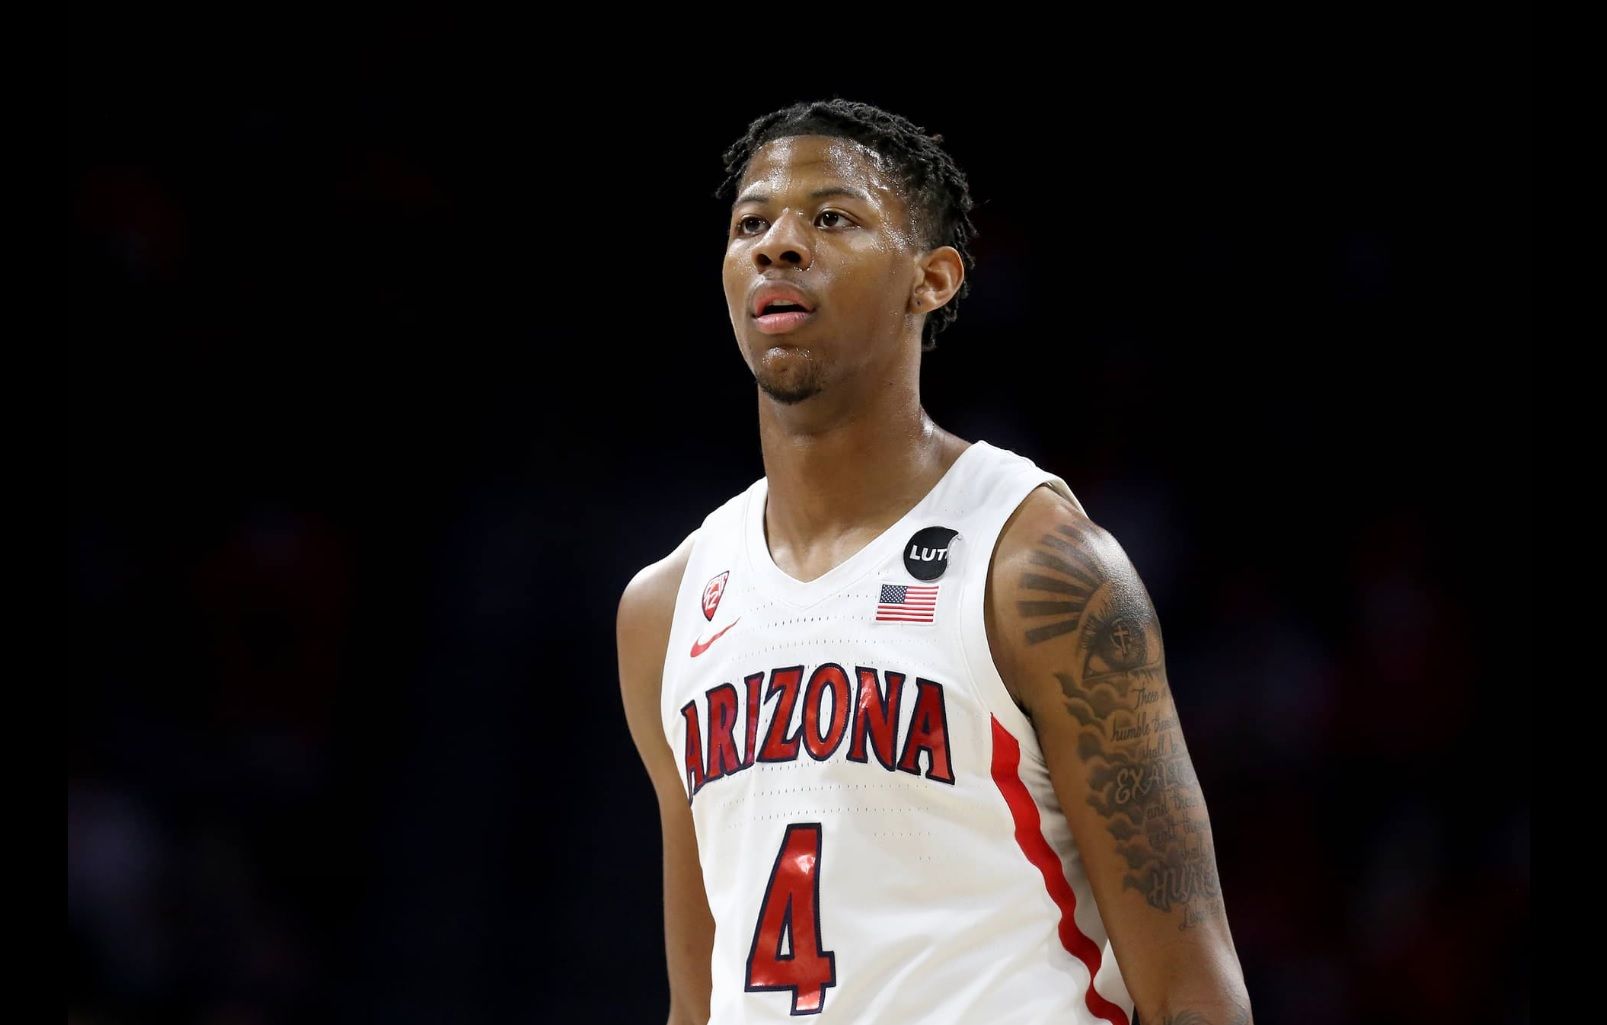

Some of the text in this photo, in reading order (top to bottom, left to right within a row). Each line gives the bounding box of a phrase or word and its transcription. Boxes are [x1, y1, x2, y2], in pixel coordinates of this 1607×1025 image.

[909, 545, 948, 562] LUT
[681, 662, 955, 806] ARIZONA
[1110, 711, 1151, 742] humble
[744, 822, 836, 1016] 4
